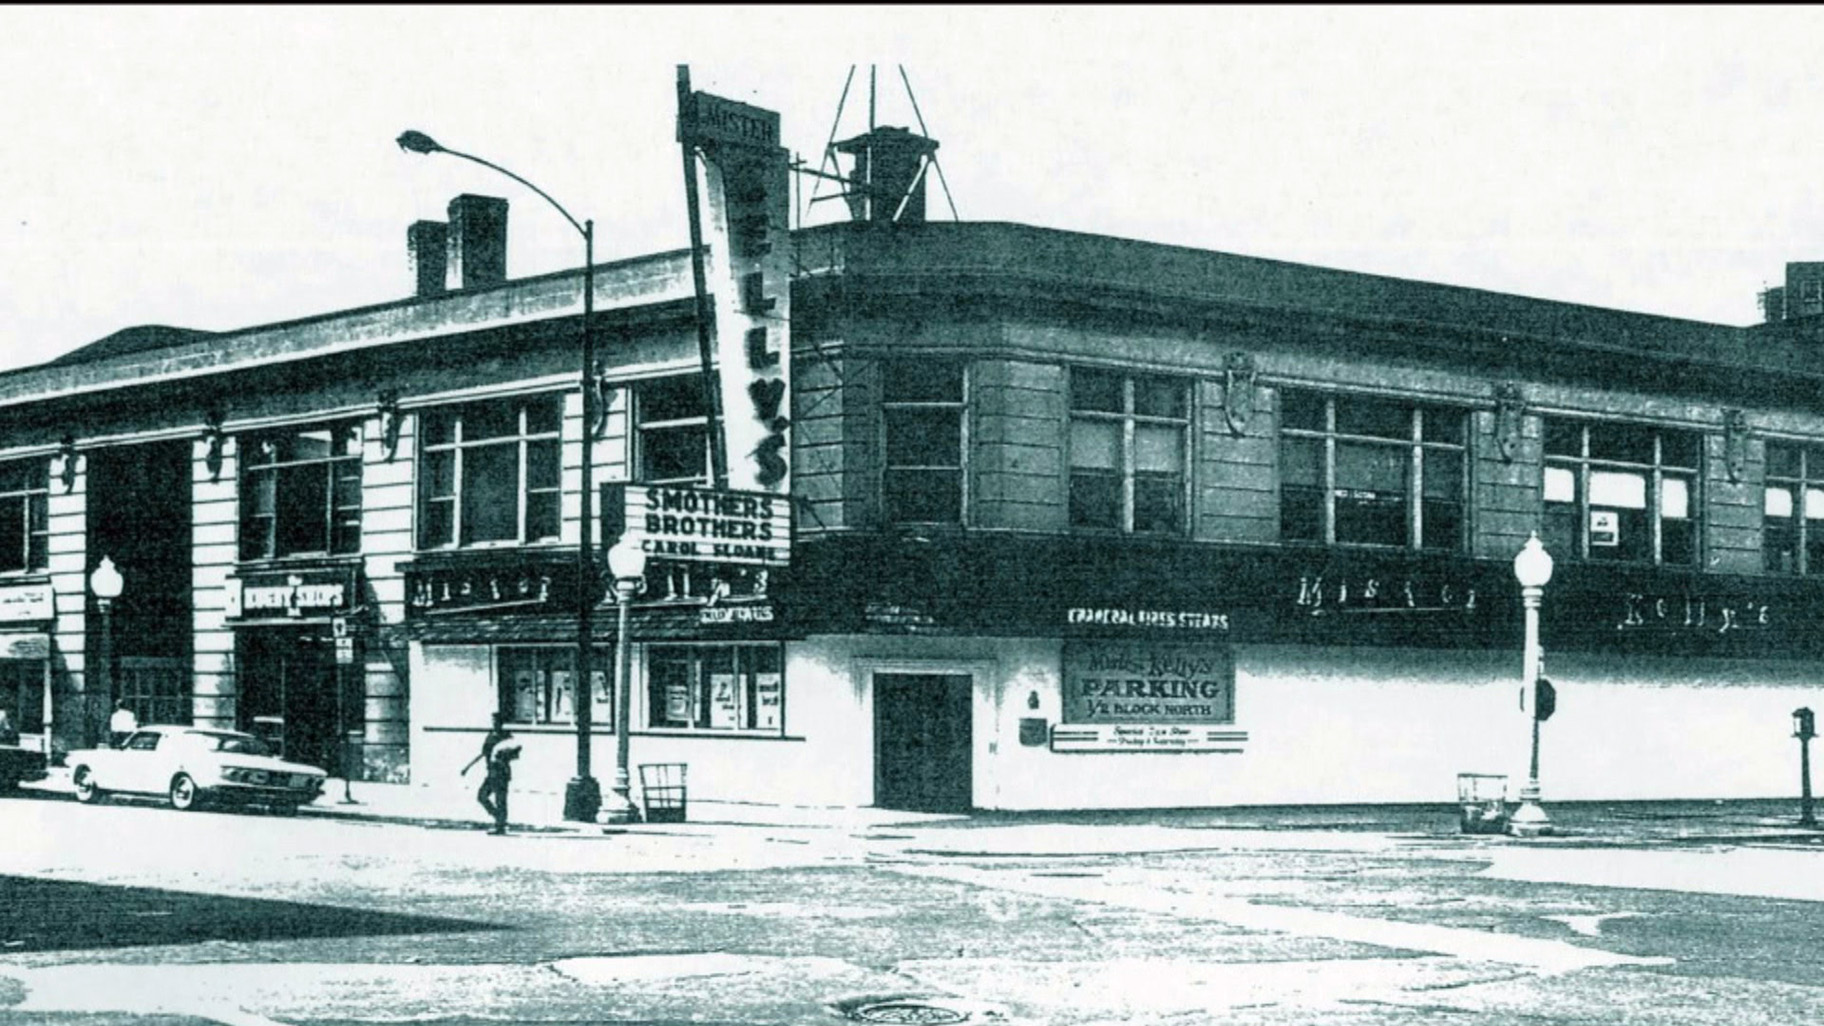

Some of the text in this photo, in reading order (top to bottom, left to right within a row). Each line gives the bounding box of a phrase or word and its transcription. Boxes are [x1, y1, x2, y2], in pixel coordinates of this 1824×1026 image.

[707, 102, 774, 141] MISTER
[645, 487, 774, 520] SMOTHERS
[645, 512, 773, 541] BROTHERS
[641, 539, 699, 554] CAROL
[1081, 679, 1219, 698] PARKING
[1114, 703, 1160, 715] BLOCK
[1164, 704, 1212, 716] NORTH
